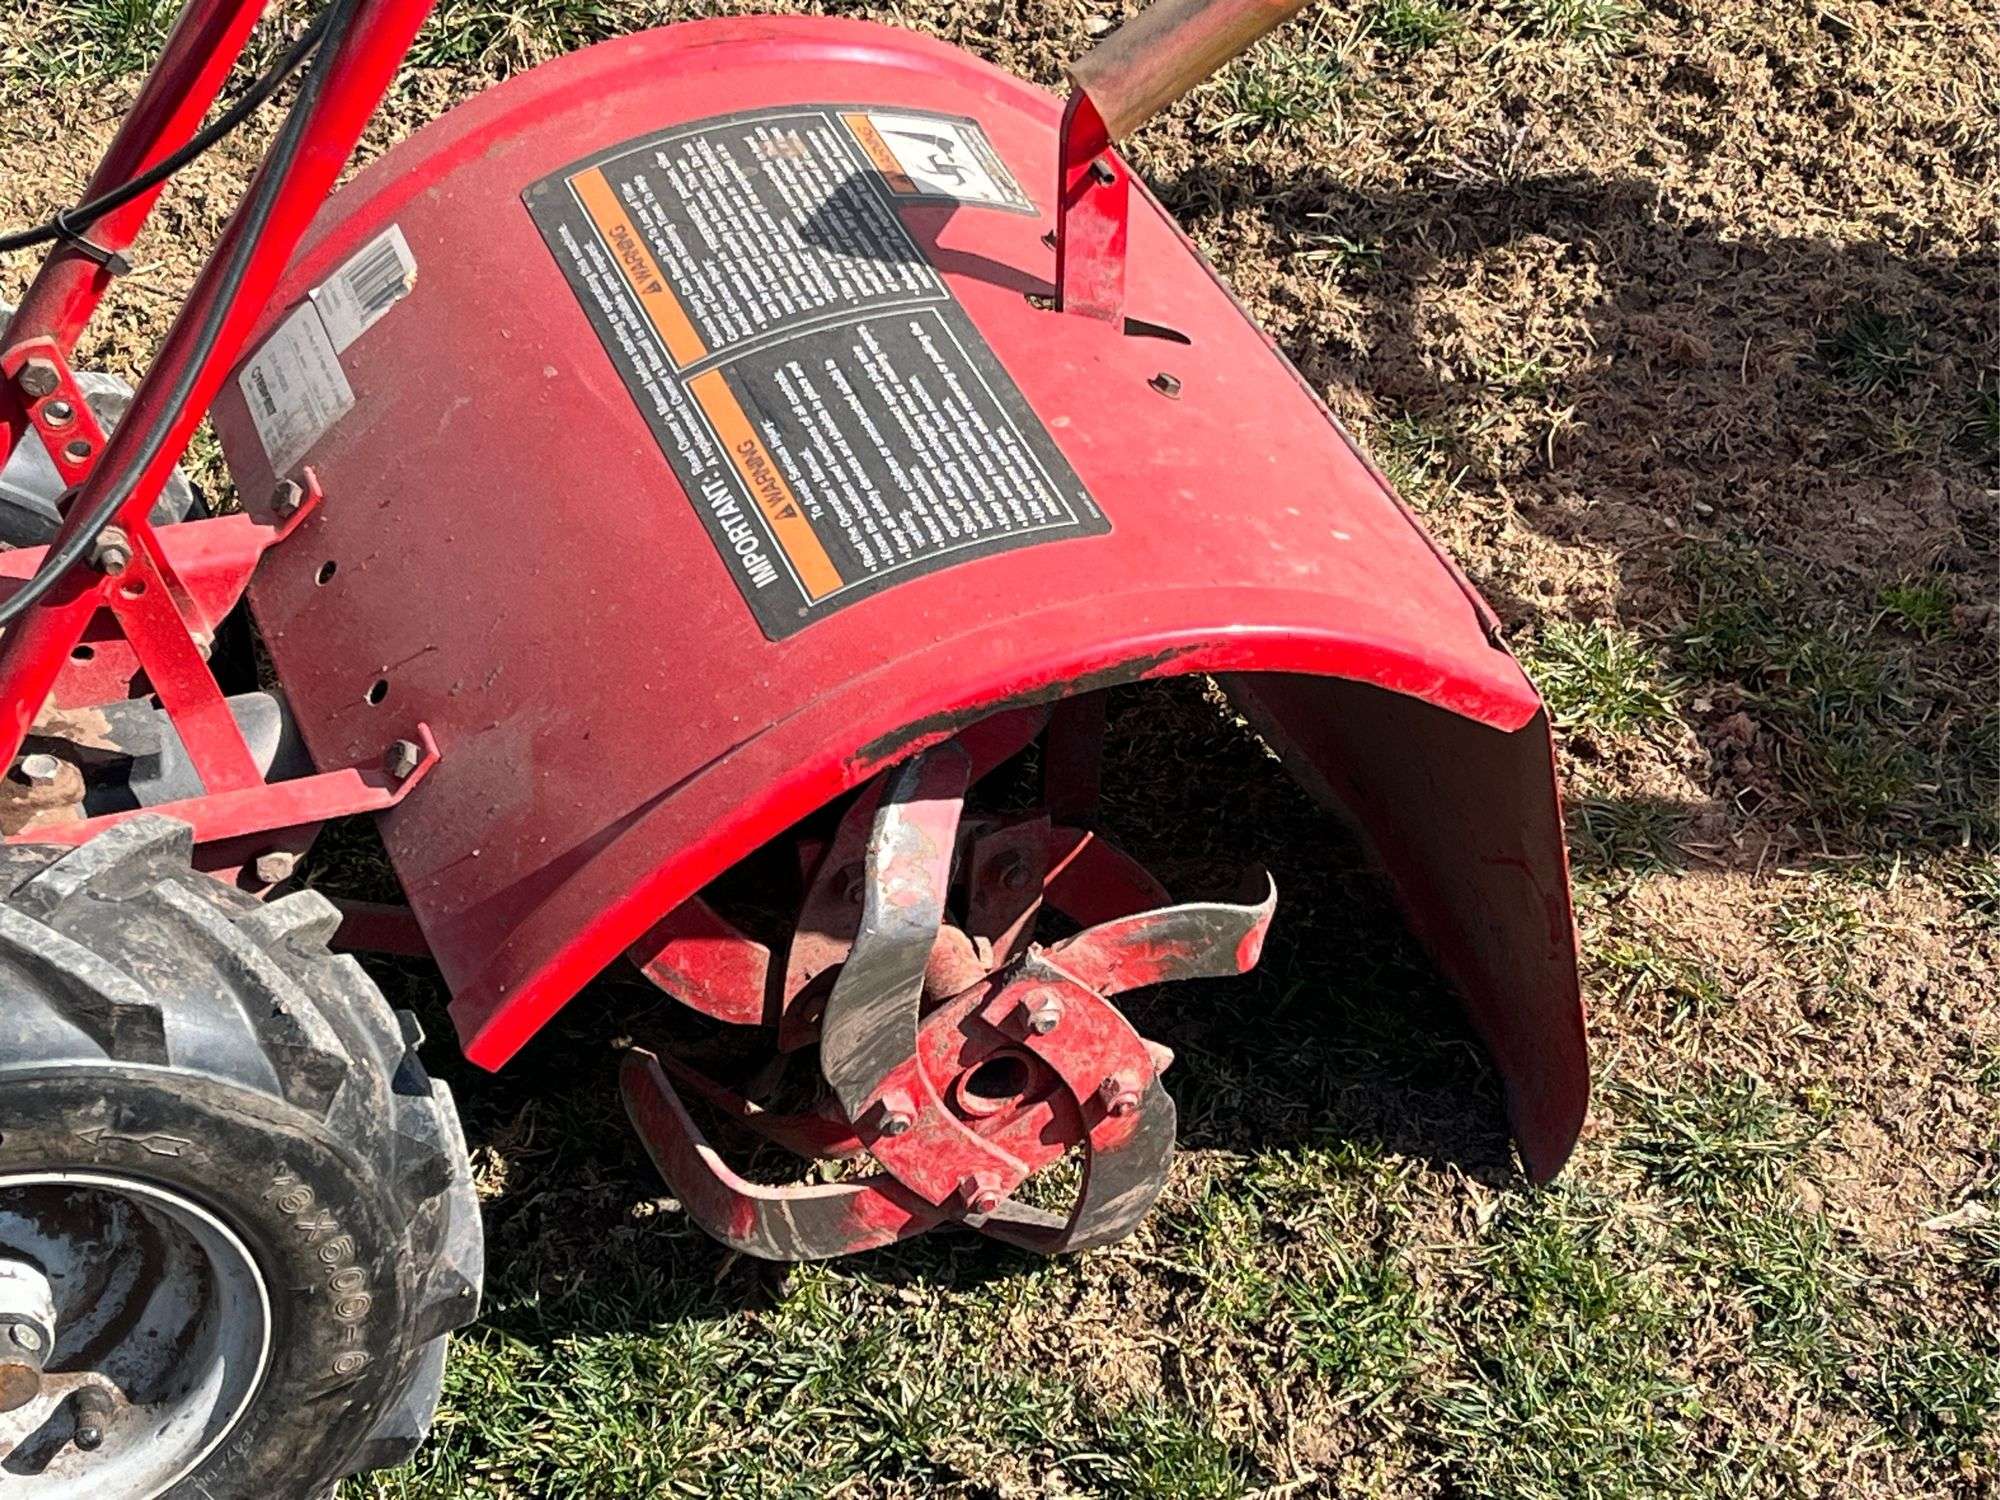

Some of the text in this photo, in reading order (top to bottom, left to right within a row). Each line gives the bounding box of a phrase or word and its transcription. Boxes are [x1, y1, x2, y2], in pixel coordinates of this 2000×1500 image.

[606, 222, 654, 284] WARNING
[681, 448, 704, 475] Read
[704, 456, 718, 468] A
[734, 438, 786, 507] WARNING
[772, 445, 802, 481] Serious
[791, 477, 817, 507] Avoid
[806, 504, 825, 520] To
[696, 470, 779, 588] IMPORTANT:
[843, 525, 863, 543] the
[852, 540, 877, 568] Read
